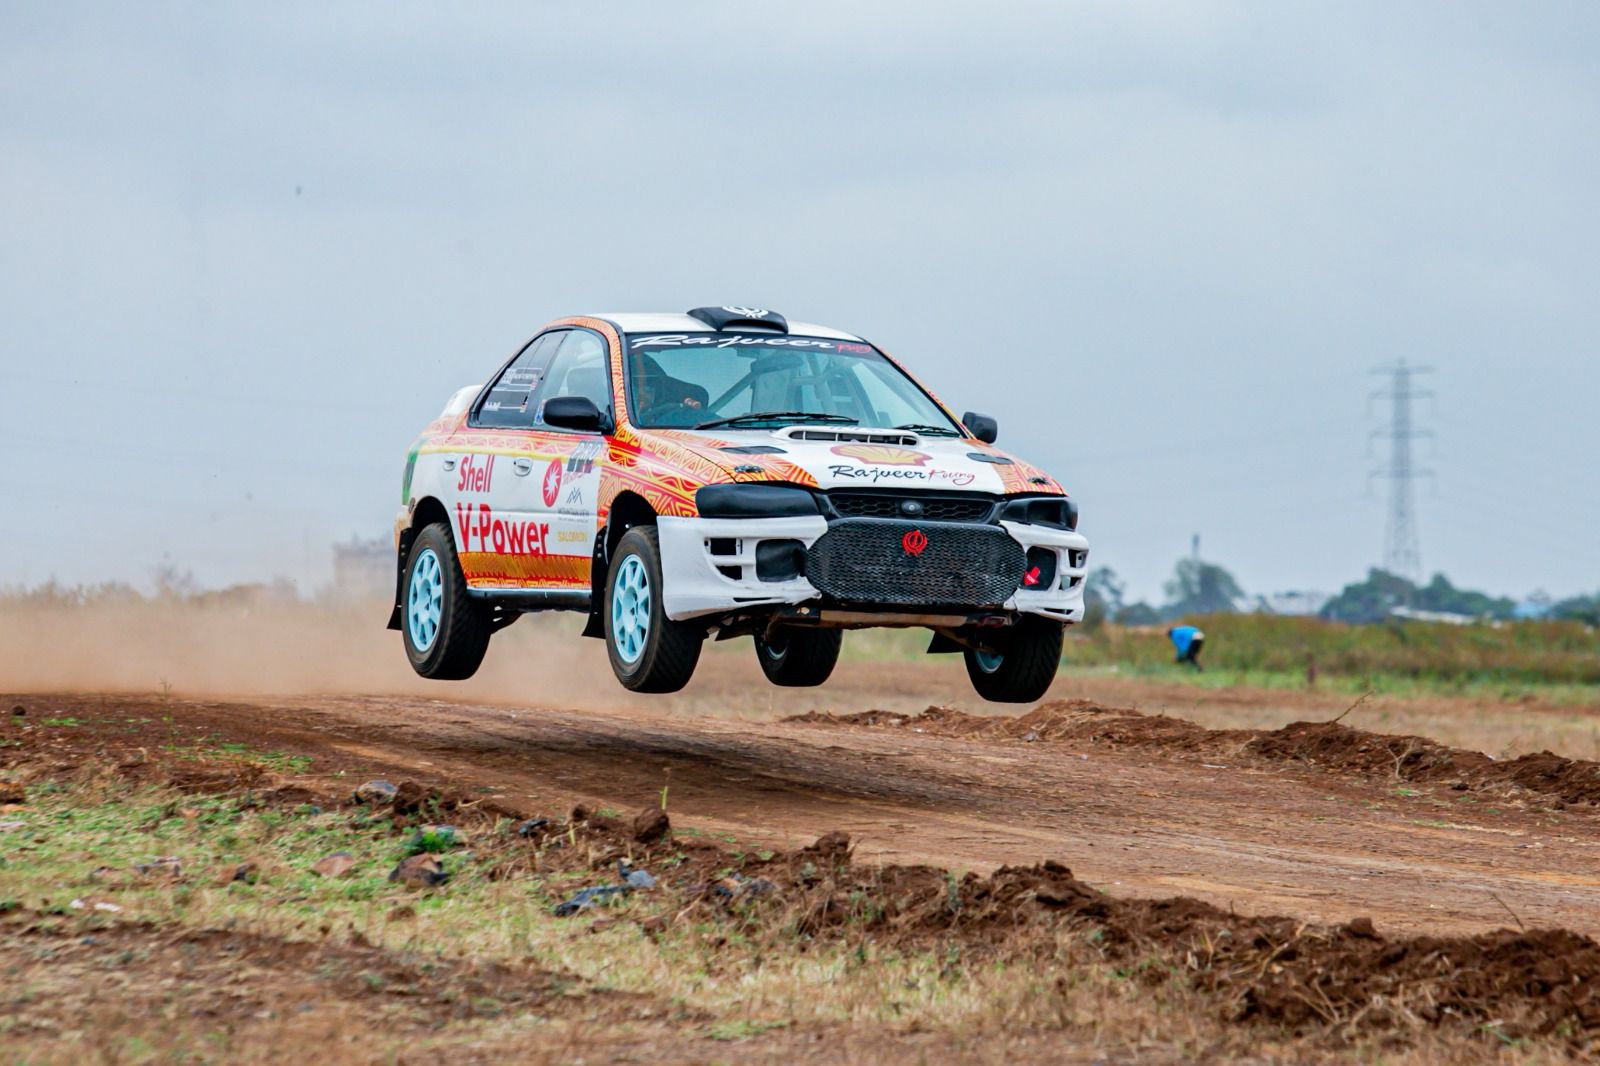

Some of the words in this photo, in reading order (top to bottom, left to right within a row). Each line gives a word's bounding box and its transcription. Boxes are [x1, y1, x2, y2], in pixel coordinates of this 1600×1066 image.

[631, 335, 835, 349] Rajveer
[457, 454, 495, 492] Shell
[828, 465, 926, 483] Rajveer
[457, 502, 549, 559] V-Power
